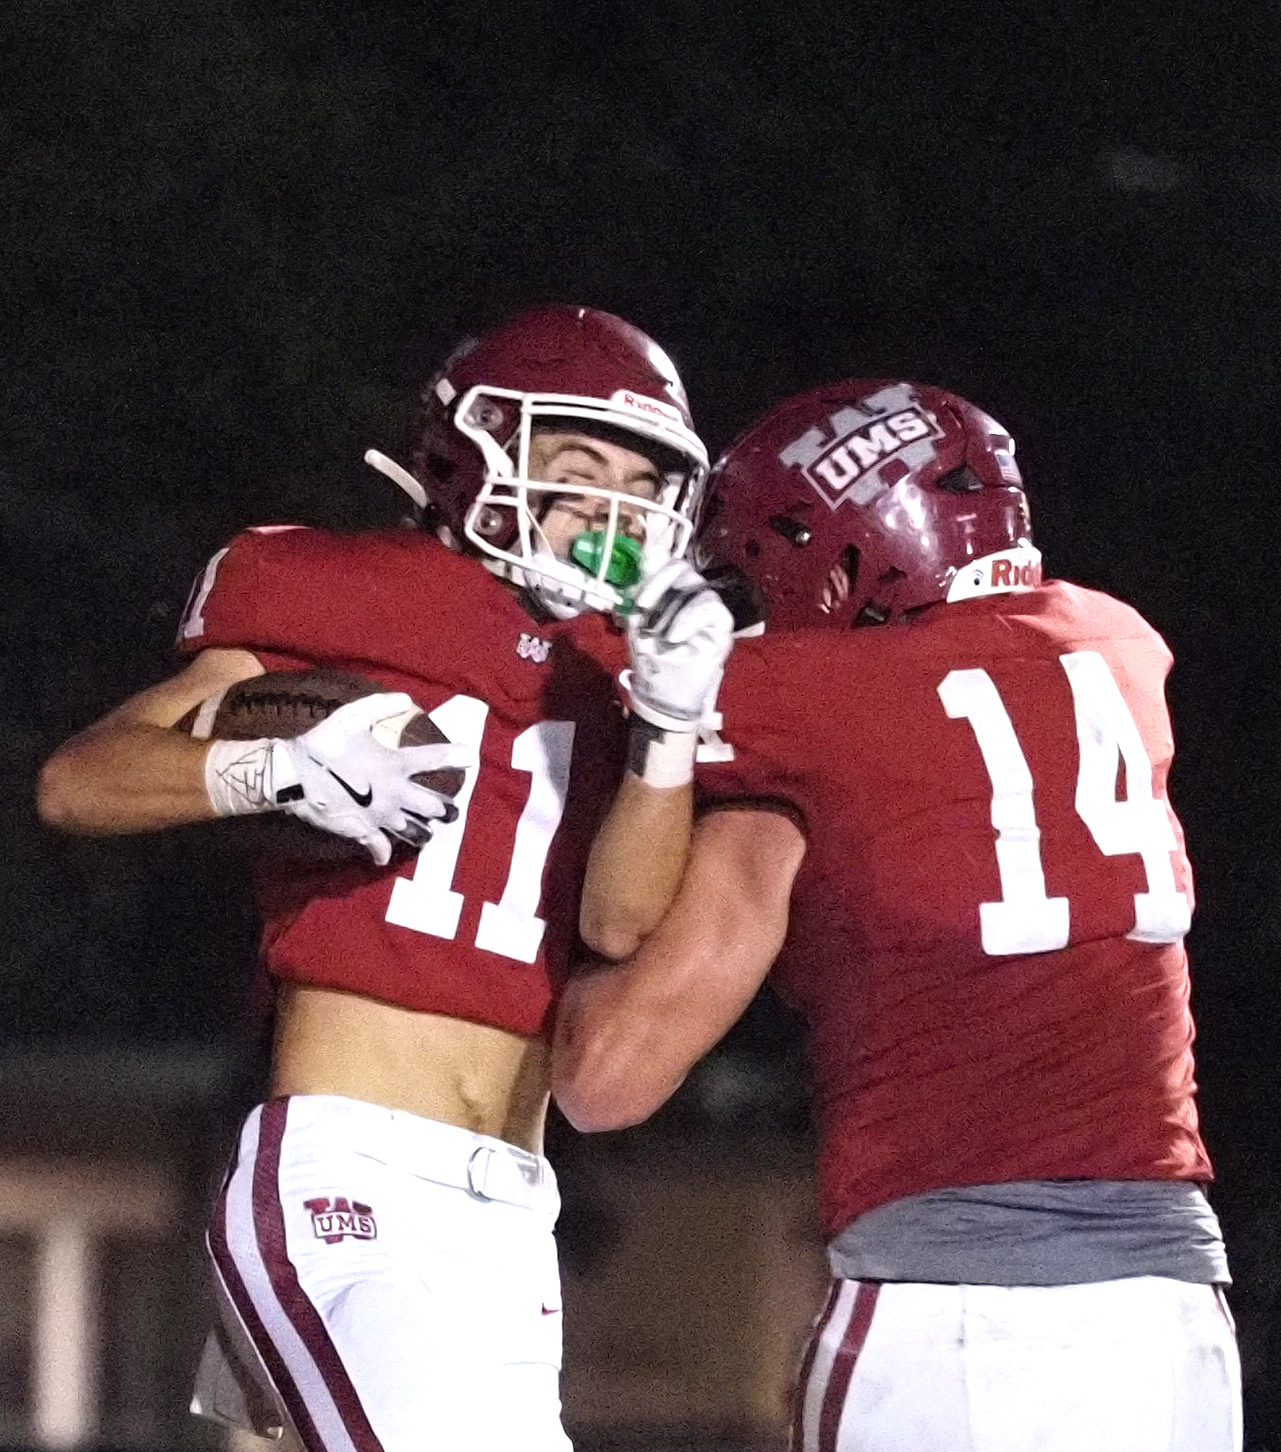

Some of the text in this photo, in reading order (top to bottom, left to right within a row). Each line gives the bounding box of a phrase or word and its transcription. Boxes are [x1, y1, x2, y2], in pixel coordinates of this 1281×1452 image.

[816, 412, 929, 490] UMS
[385, 694, 575, 963] 11
[936, 651, 1192, 956] 14
[316, 1214, 372, 1233] UMS
